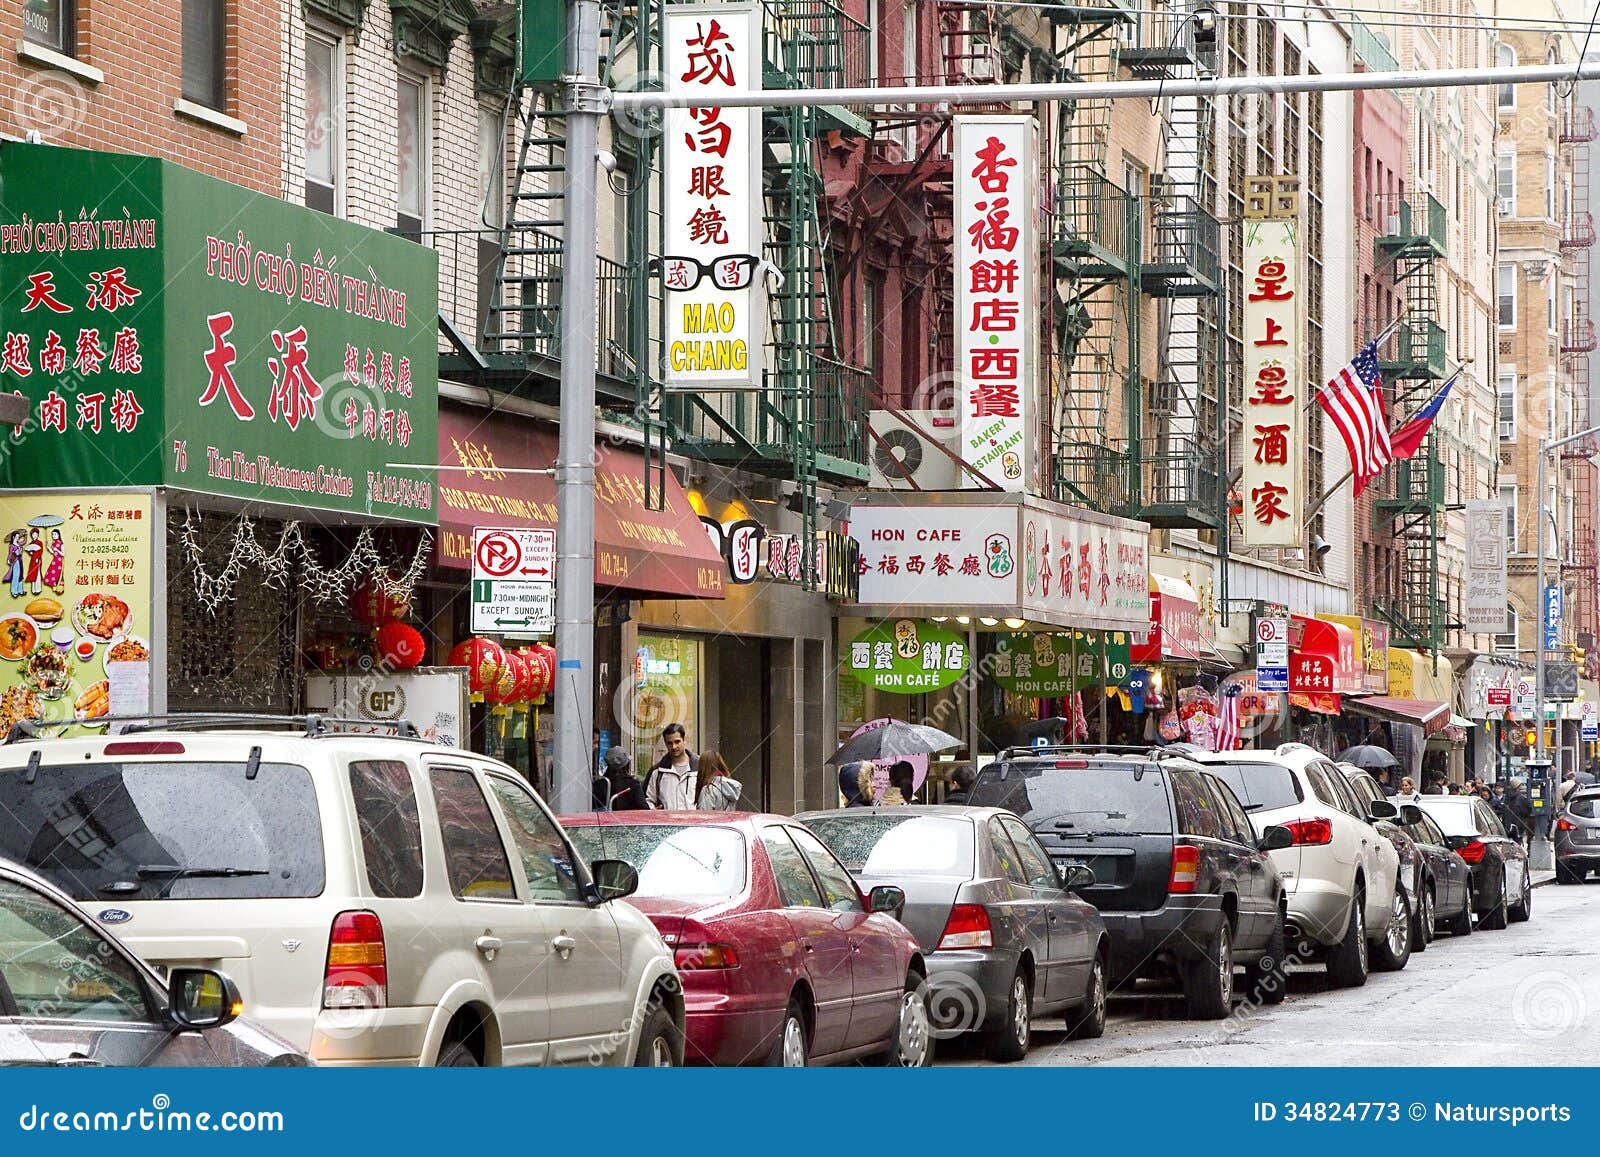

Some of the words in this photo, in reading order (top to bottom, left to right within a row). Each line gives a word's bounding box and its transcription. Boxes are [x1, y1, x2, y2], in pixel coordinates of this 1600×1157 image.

[102, 206, 156, 250] THÀNH
[21, 267, 142, 313] 天添
[343, 266, 407, 328] THÀNH
[683, 301, 735, 334] MAO
[1, 327, 143, 375] 越南餐廳
[670, 339, 747, 372] CHANG
[199, 311, 323, 432] 天添
[343, 343, 412, 398] 越南餐廳
[1248, 258, 1294, 525] 皇上皇酒家
[344, 398, 412, 448] 牛肉河粉
[970, 418, 1007, 448] BAKERY
[174, 440, 188, 473] 76
[990, 439, 998, 447] &
[207, 446, 231, 479] Tian
[232, 450, 257, 484] Tian
[257, 455, 316, 492] Vietnamese
[316, 464, 353, 498] Cuisine
[69, 504, 104, 520] 天添
[440, 486, 469, 510] GOOD
[465, 490, 494, 513] FIELD
[489, 495, 532, 519] TRADING
[81, 546, 129, 554] 212-925-8420
[443, 532, 457, 557] NO.
[871, 529, 905, 542] HON
[917, 529, 961, 542] CAFE
[600, 552, 611, 575] NO.
[697, 568, 708, 588] NO.
[480, 581, 486, 601] 1
[480, 606, 510, 615] EXCEPT
[514, 606, 544, 615] SUNDAY
[875, 674, 902, 686] HON
[907, 672, 940, 686] CAFÉ
[1016, 682, 1040, 691] HON
[1044, 679, 1072, 691] CAFÉ
[370, 691, 396, 712] GF
[103, 910, 126, 921] Ford
